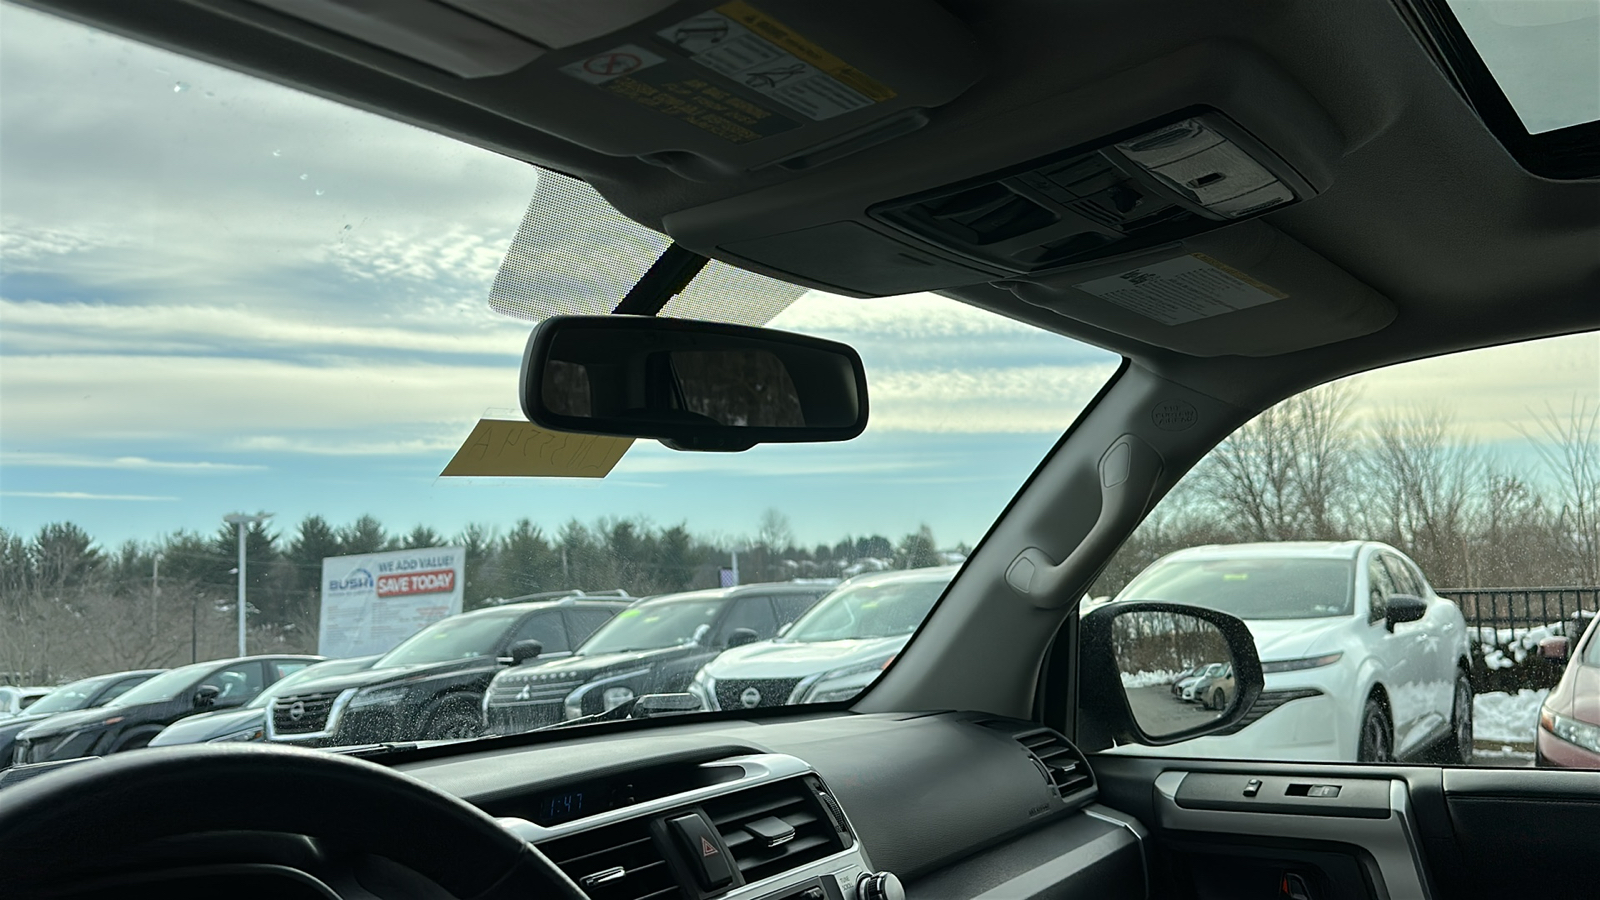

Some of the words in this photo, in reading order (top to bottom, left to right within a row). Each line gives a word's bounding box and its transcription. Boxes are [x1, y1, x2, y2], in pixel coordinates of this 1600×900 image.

[378, 560, 394, 572] WE
[396, 559, 418, 570] ADD
[329, 577, 369, 591] BUSH
[378, 577, 409, 593] SAVE
[411, 572, 453, 590] TODAY
[550, 793, 583, 817] 1:47
